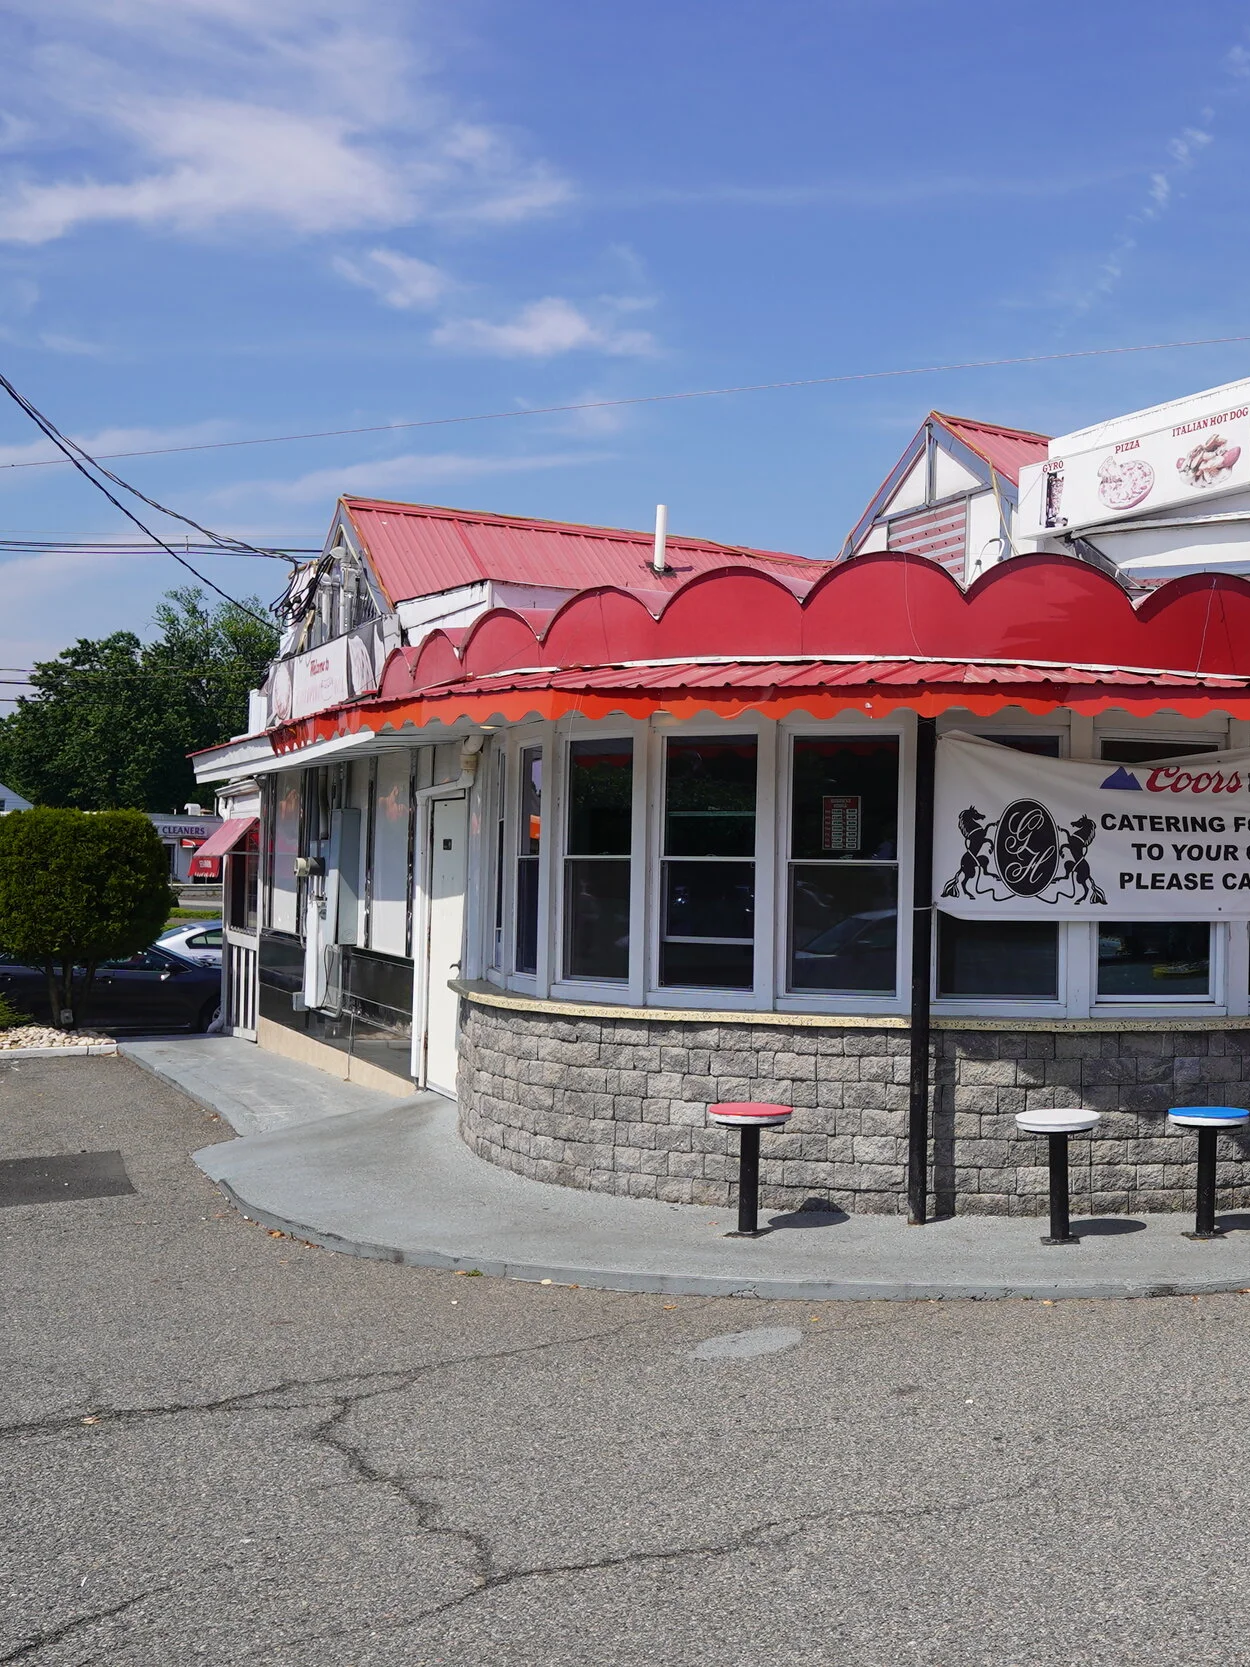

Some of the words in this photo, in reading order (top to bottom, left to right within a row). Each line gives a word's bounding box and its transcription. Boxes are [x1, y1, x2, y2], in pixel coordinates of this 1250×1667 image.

[1172, 418, 1208, 437] ITALIAN
[1210, 413, 1228, 427] HOT
[1229, 407, 1249, 421] DOG
[1115, 439, 1140, 454] PIZZA
[1042, 460, 1064, 473] GYRO
[1146, 766, 1242, 793] Coors
[162, 825, 206, 835] CLEANERS
[1101, 813, 1226, 833] CATERING
[1131, 843, 1164, 861] TO
[1172, 844, 1239, 862] YOUR
[1119, 872, 1214, 891] PLEASE
